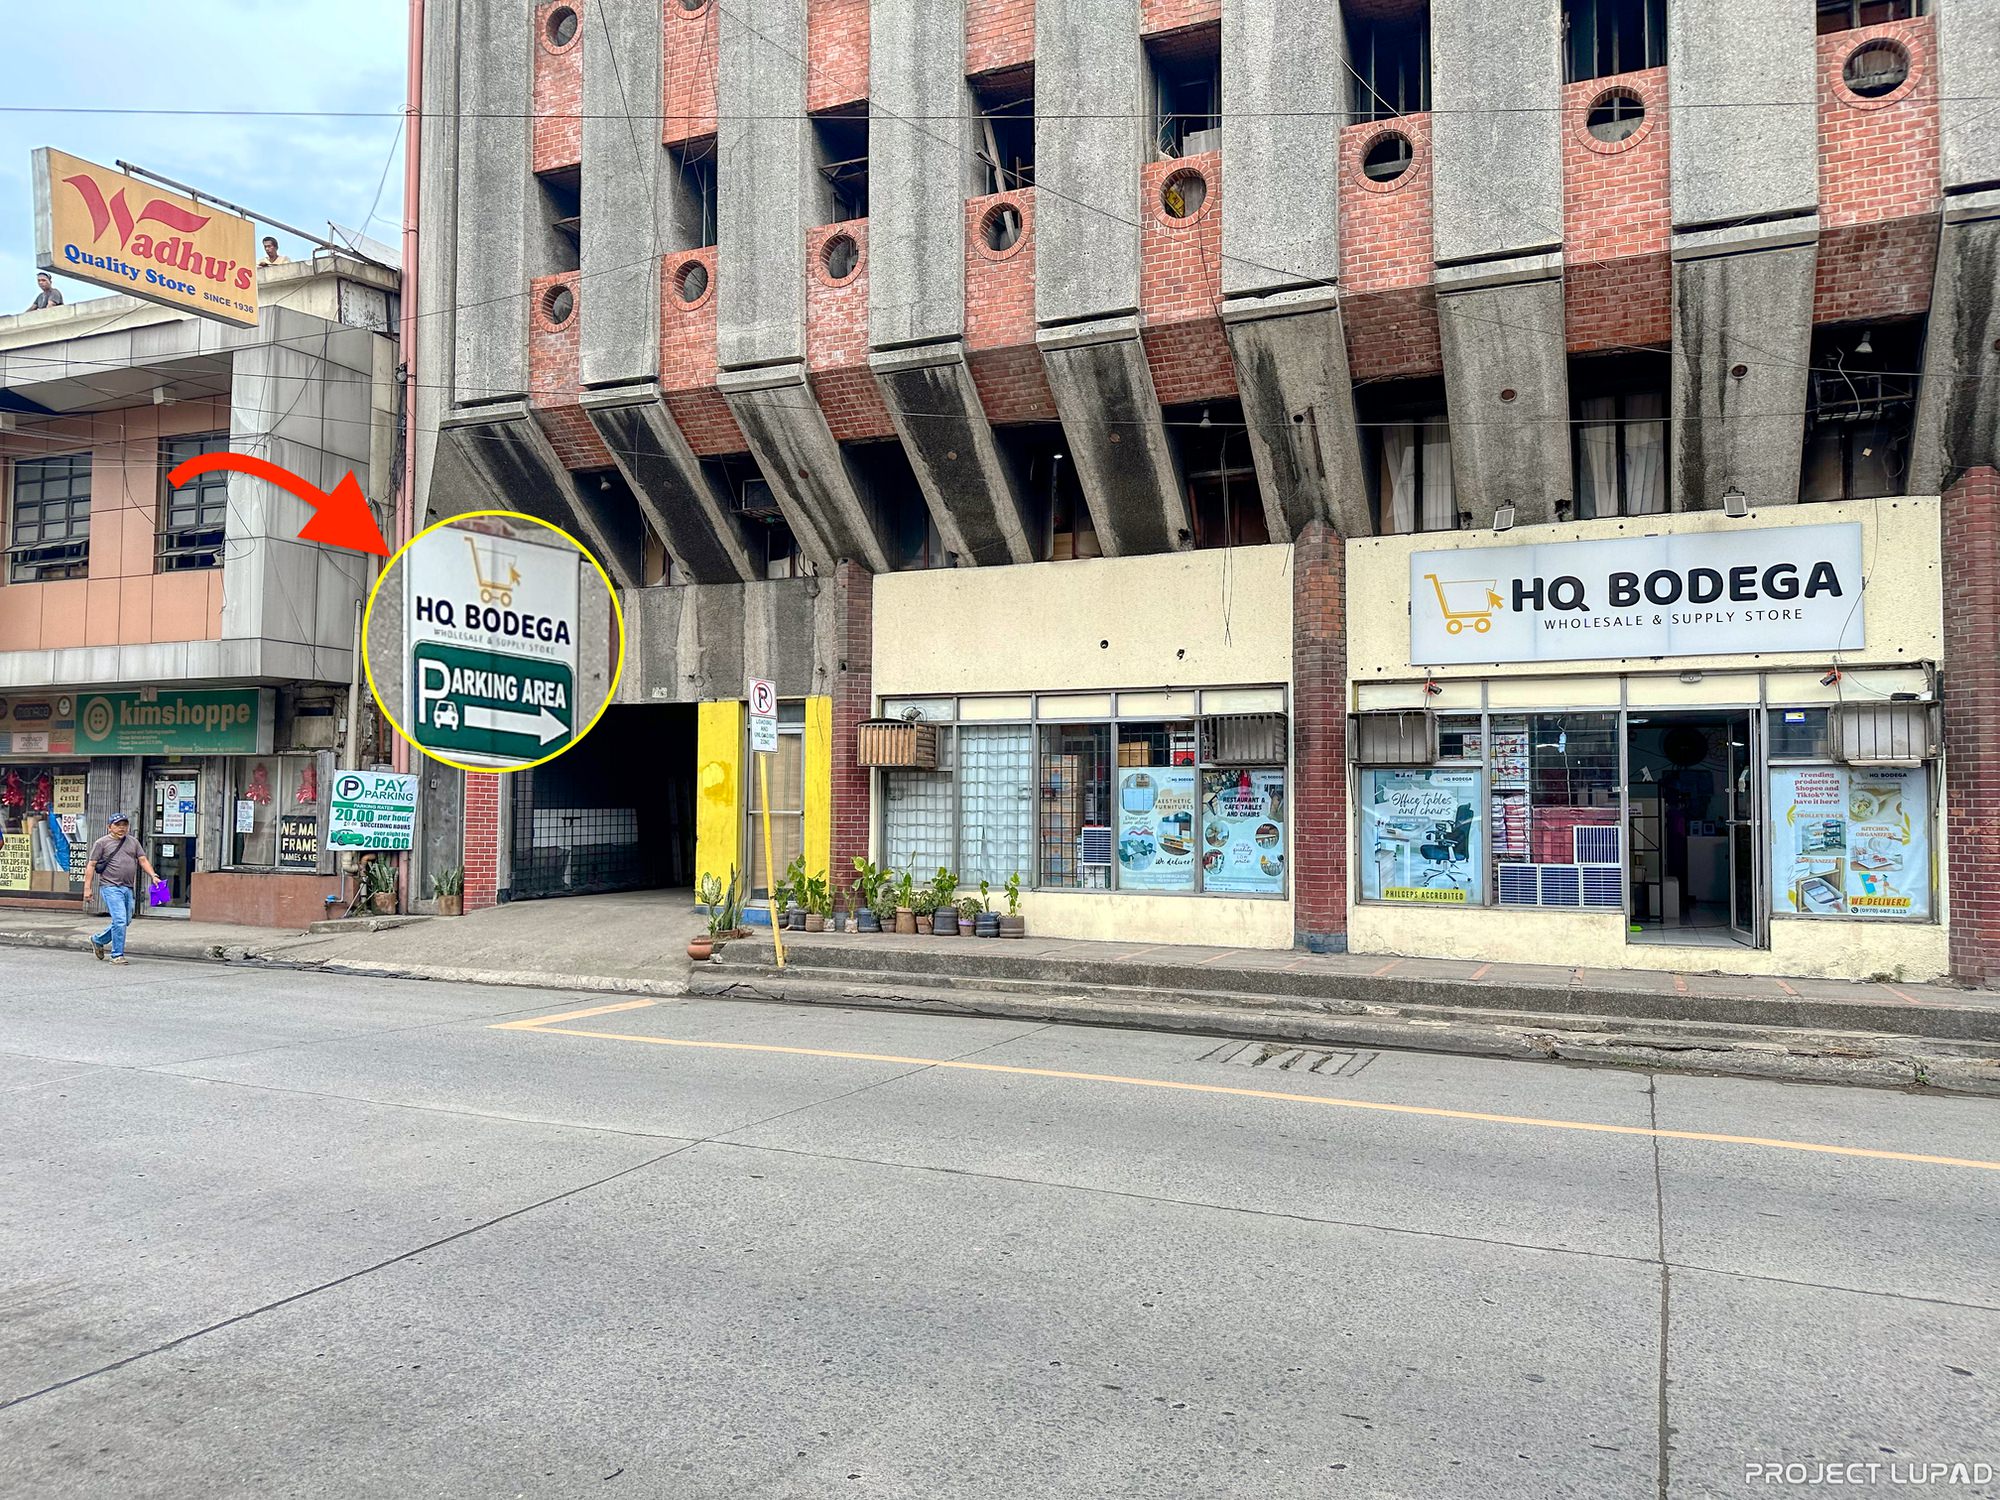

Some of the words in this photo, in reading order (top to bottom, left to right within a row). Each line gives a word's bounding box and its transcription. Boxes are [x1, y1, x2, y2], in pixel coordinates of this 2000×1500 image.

[62, 174, 253, 290] Wadhu's
[64, 243, 140, 282] Quality
[145, 268, 196, 296] Store
[203, 292, 231, 308] SINCE
[233, 301, 254, 314] 1936
[1512, 575, 1590, 612] HQ
[1608, 561, 1843, 607] BODEGA
[416, 595, 456, 628] HQ
[465, 603, 571, 645] BODEGA
[1544, 615, 1644, 630] WHOLESALE
[1652, 615, 1663, 625] &
[1672, 611, 1735, 625] SUPPLY
[1745, 608, 1803, 621] STORE
[434, 628, 483, 643] WHOLESALE
[496, 638, 526, 650] SUPPLY
[529, 644, 555, 655] STORE
[418, 658, 518, 723] PARKING
[522, 678, 566, 709] AREA
[120, 698, 250, 732] kimshoppe
[343, 780, 359, 796] P
[375, 778, 407, 792] PAY
[364, 790, 414, 801] PARKING
[1391, 793, 1420, 807] Office
[1421, 792, 1452, 805] tables
[335, 808, 374, 822] 20.00
[378, 814, 390, 822] per
[392, 814, 410, 822] hour
[1399, 804, 1418, 815] and
[1420, 805, 1451, 815] chairs
[63, 824, 75, 832] OFF
[282, 838, 317, 852] FRAME
[364, 835, 409, 849] 200.00
[1386, 890, 1418, 899] PHILGEPS
[1421, 891, 1464, 900] ACCREDITED
[1851, 897, 1864, 905] WE
[1867, 898, 1907, 906] DELIVER!
